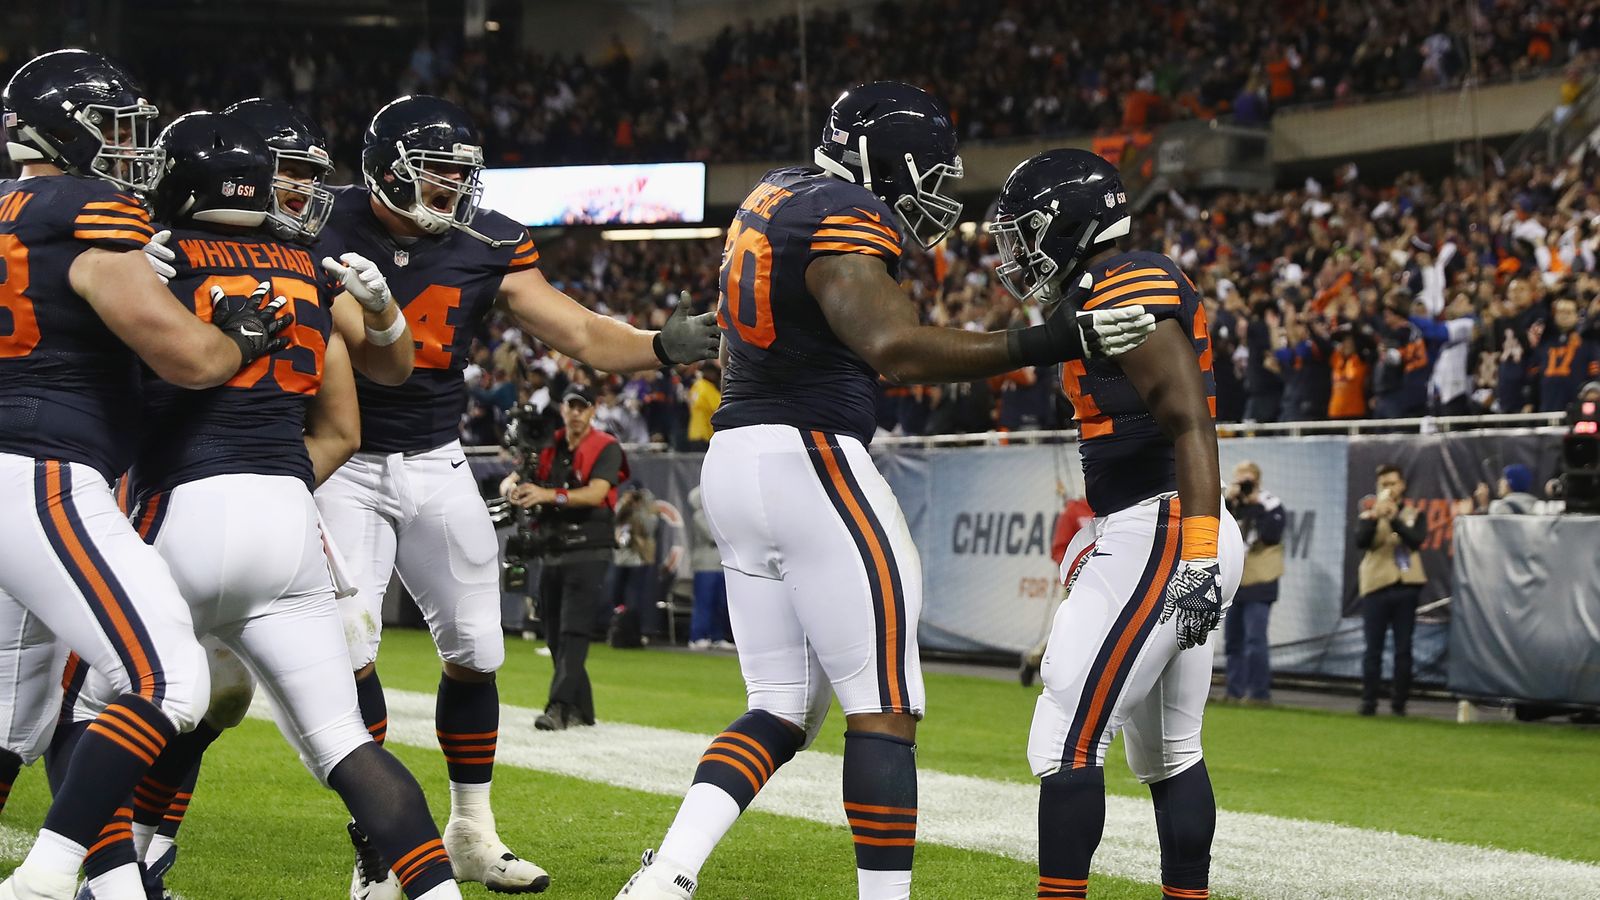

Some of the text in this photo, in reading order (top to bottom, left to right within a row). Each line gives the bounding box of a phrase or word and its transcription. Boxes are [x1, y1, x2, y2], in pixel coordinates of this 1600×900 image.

[237, 184, 255, 197] GSH
[178, 239, 317, 281] WHITEHAIR
[953, 512, 1060, 555] CHICA
[673, 873, 695, 894] NIKE
